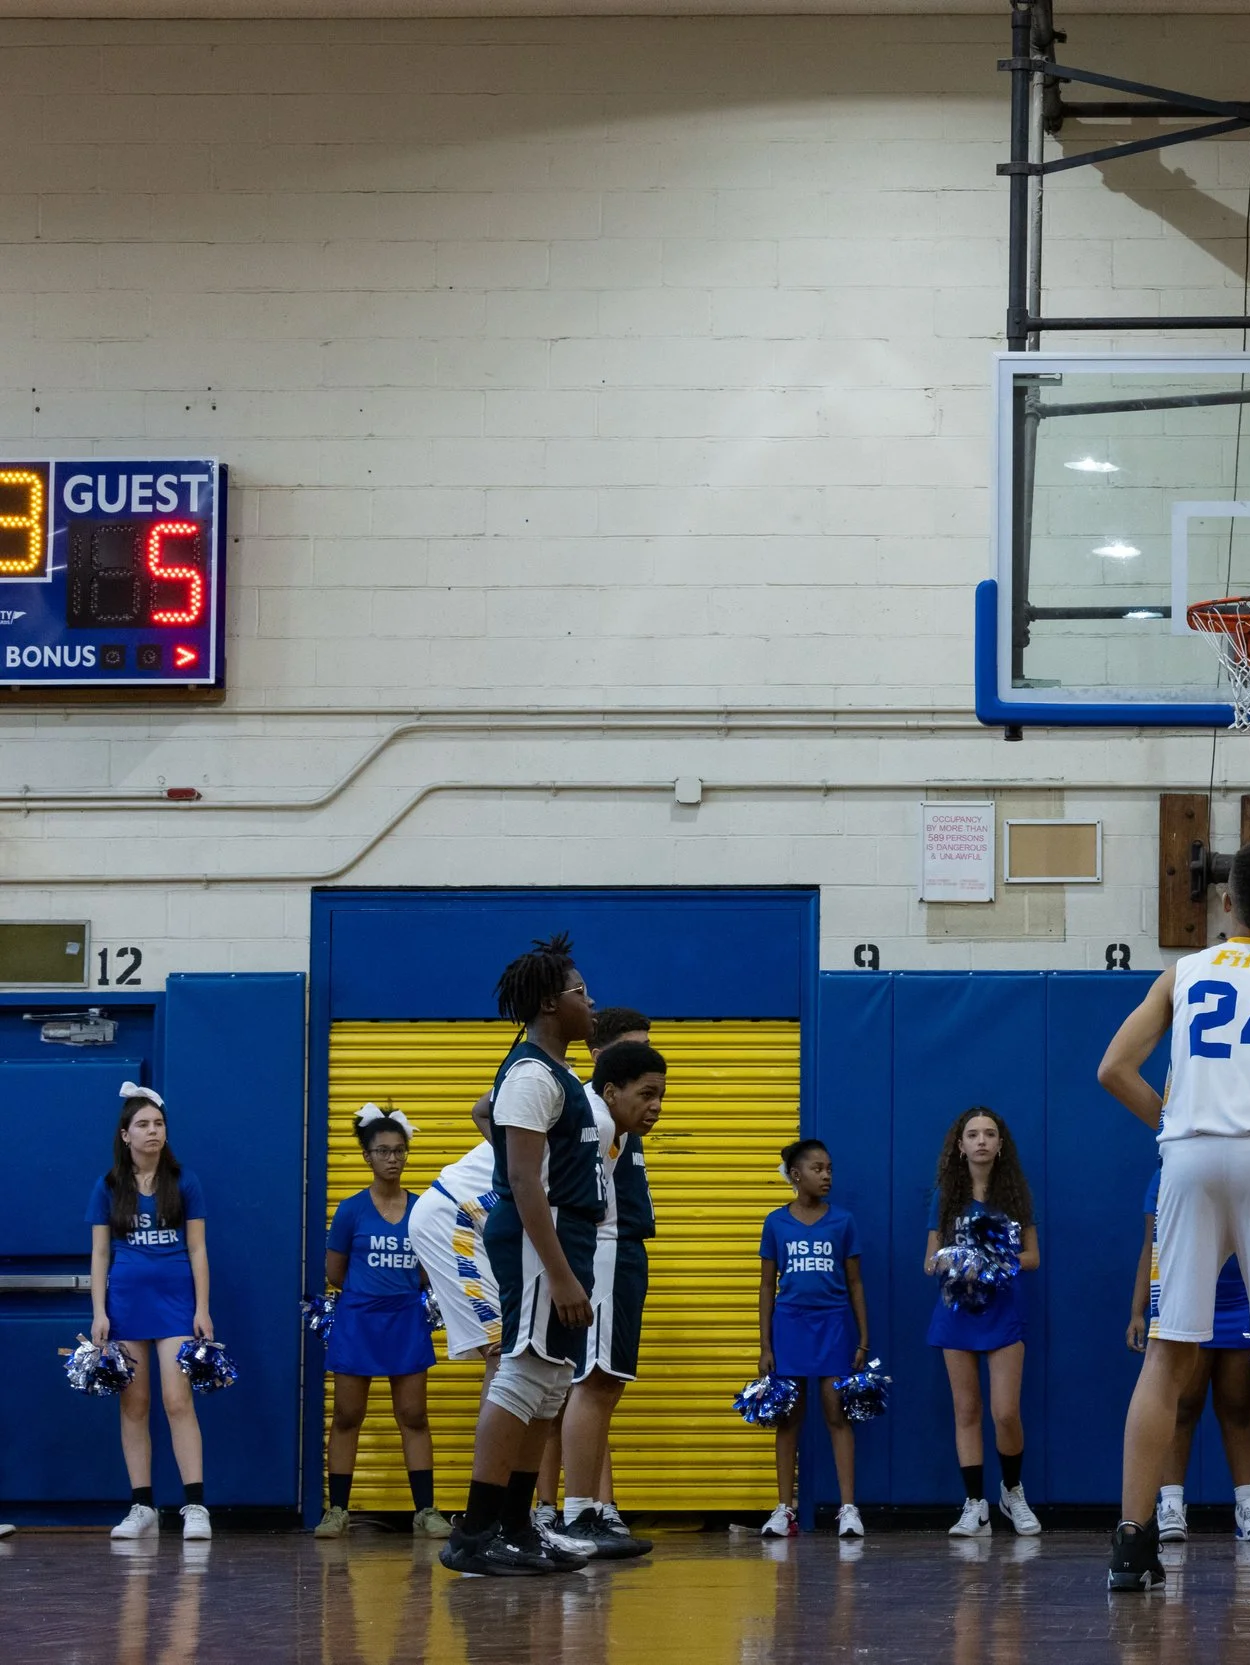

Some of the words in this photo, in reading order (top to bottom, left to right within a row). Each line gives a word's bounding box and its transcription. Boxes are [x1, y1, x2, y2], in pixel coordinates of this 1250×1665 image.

[63, 474, 208, 513] GUEST
[148, 522, 201, 623] 5
[6, 645, 96, 668] BONUS
[932, 815, 983, 823] OCCUPANCY
[926, 824, 937, 832] BY
[928, 834, 945, 842] 589
[936, 844, 988, 852] DANGEROUS
[939, 853, 983, 861] UNLAWFUL
[854, 944, 880, 971] 9
[97, 946, 142, 986] 12
[126, 1229, 179, 1245] CHEER
[370, 1235, 398, 1251] MS
[403, 1237, 412, 1252] 5
[786, 1240, 809, 1256] MS
[812, 1241, 833, 1256] 50
[786, 1257, 834, 1274] CHEER
